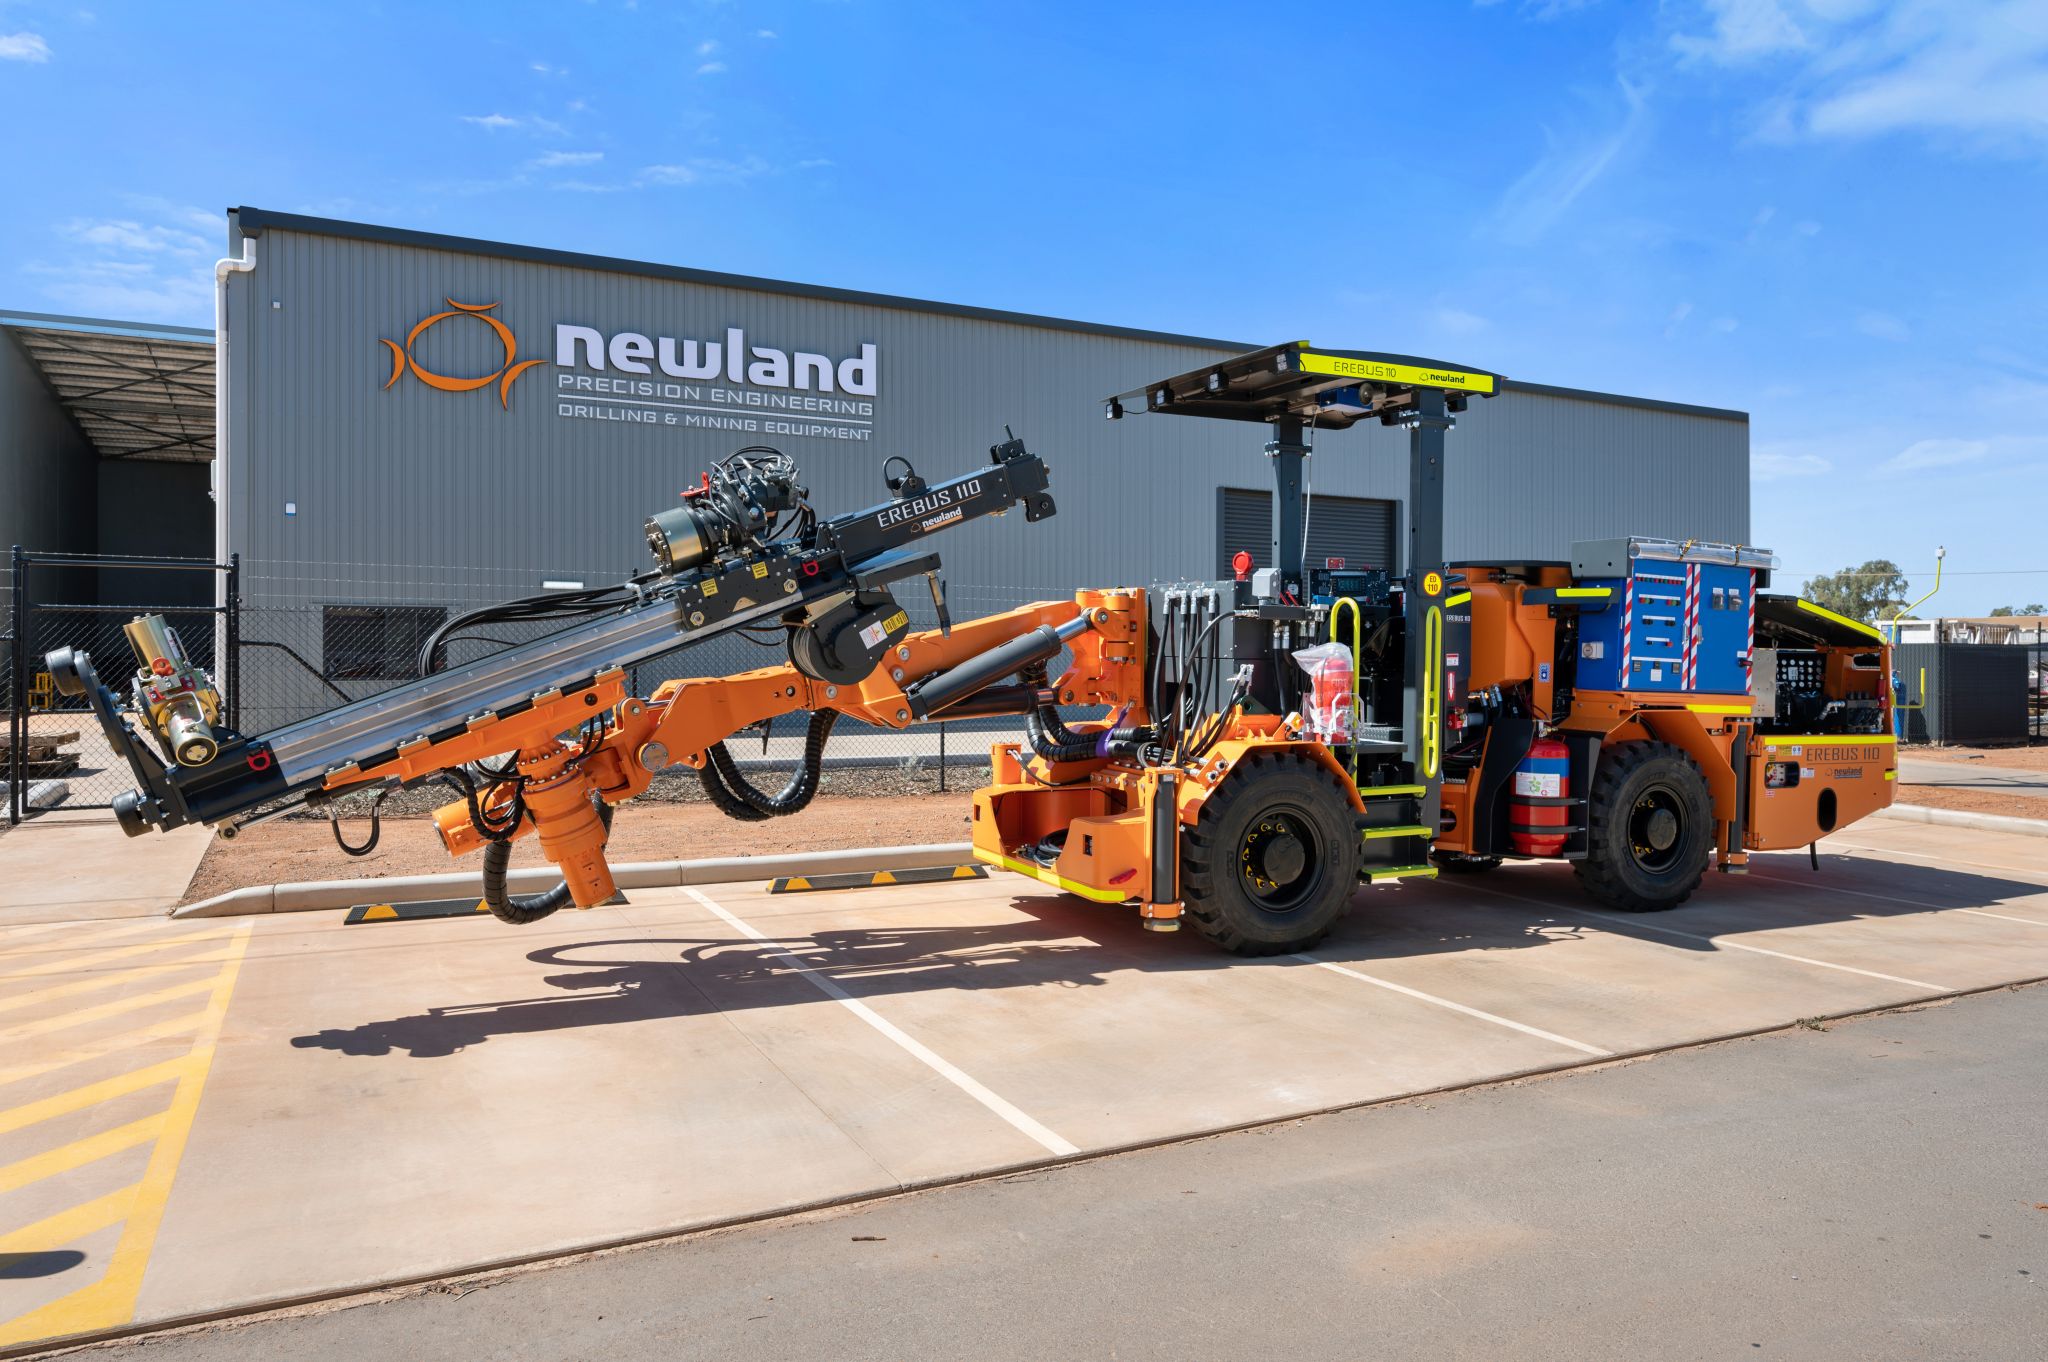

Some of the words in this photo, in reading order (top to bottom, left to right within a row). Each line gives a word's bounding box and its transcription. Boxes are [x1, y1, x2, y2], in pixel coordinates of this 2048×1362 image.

[556, 323, 877, 397] newland
[1333, 361, 1384, 377] EREBUS
[1385, 367, 1397, 378] 110
[1430, 373, 1465, 384] newland
[557, 374, 701, 400] PRECISION
[711, 388, 873, 416] ENGINEERING
[557, 403, 657, 423] DRILLING
[664, 413, 678, 425] &
[685, 415, 757, 432] MINING
[765, 421, 873, 441] EQUIPMENT
[877, 490, 951, 528] EREBUS
[956, 479, 981, 500] 110
[921, 505, 962, 528] newland
[1428, 584, 1438, 592] 110
[1806, 747, 1859, 762] EREBUS
[1863, 747, 1880, 760] 110
[1833, 766, 1863, 776] newland
